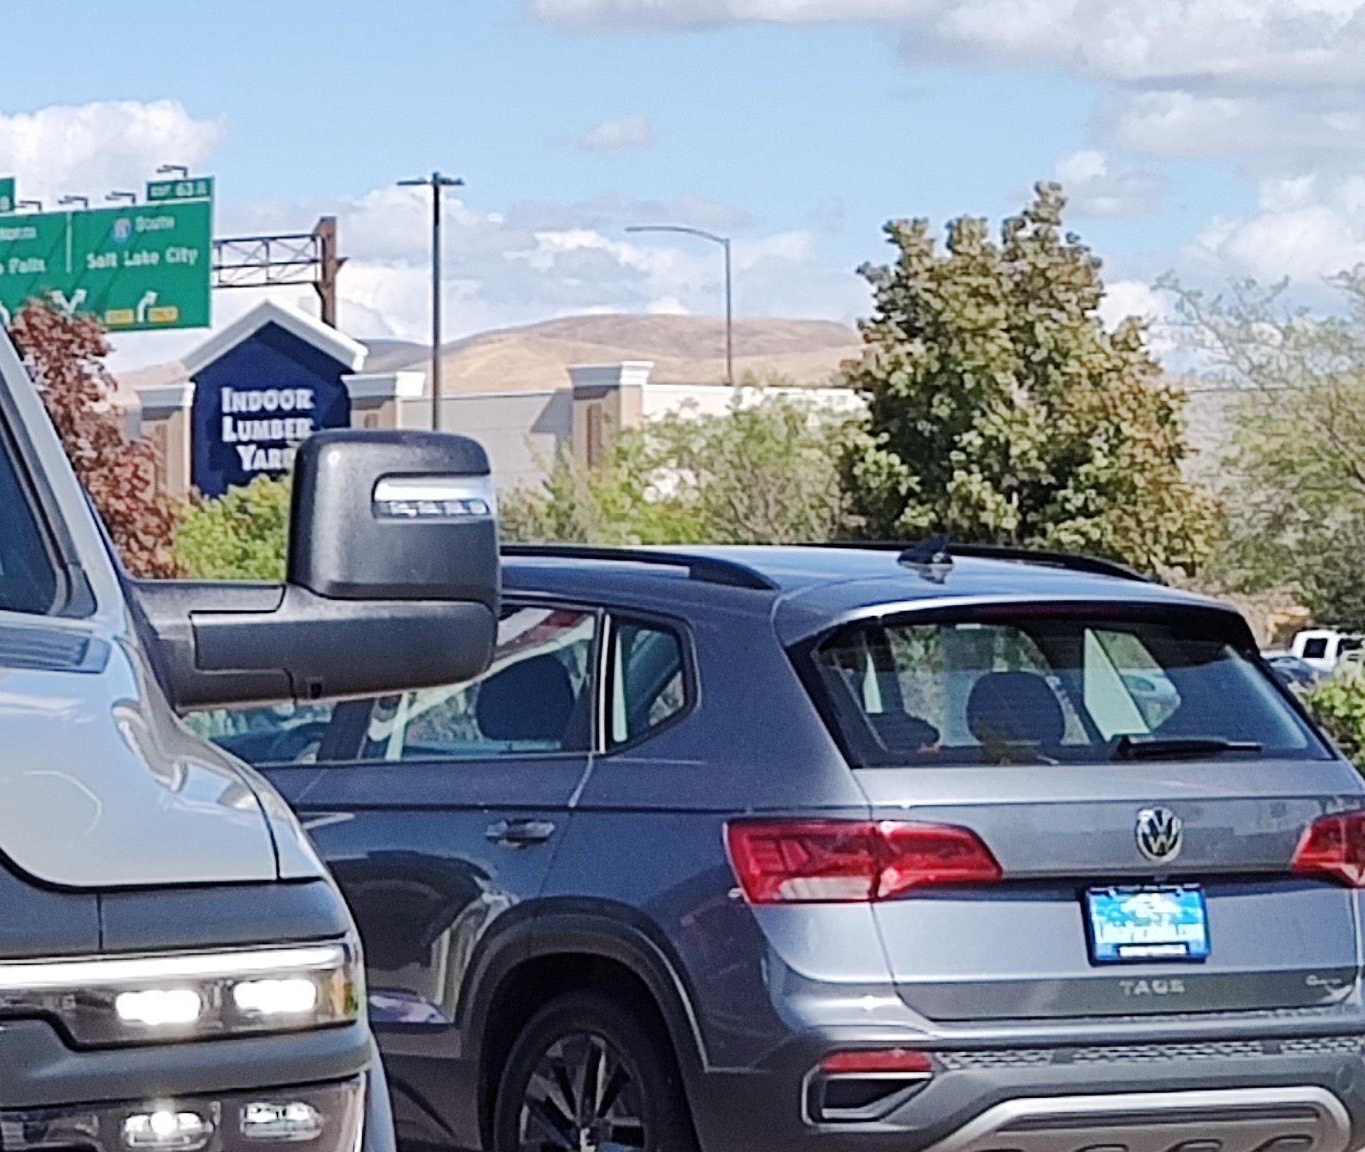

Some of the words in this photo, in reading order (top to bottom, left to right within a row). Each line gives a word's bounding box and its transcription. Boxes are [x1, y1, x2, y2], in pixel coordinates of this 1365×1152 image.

[8, 256, 46, 275] Falls
[87, 252, 118, 269] Salt
[124, 249, 160, 267] Lake
[166, 246, 199, 266] City
[221, 386, 316, 413] INDOOR
[222, 415, 315, 442] LUMBER
[1118, 978, 1187, 996] TAOS
